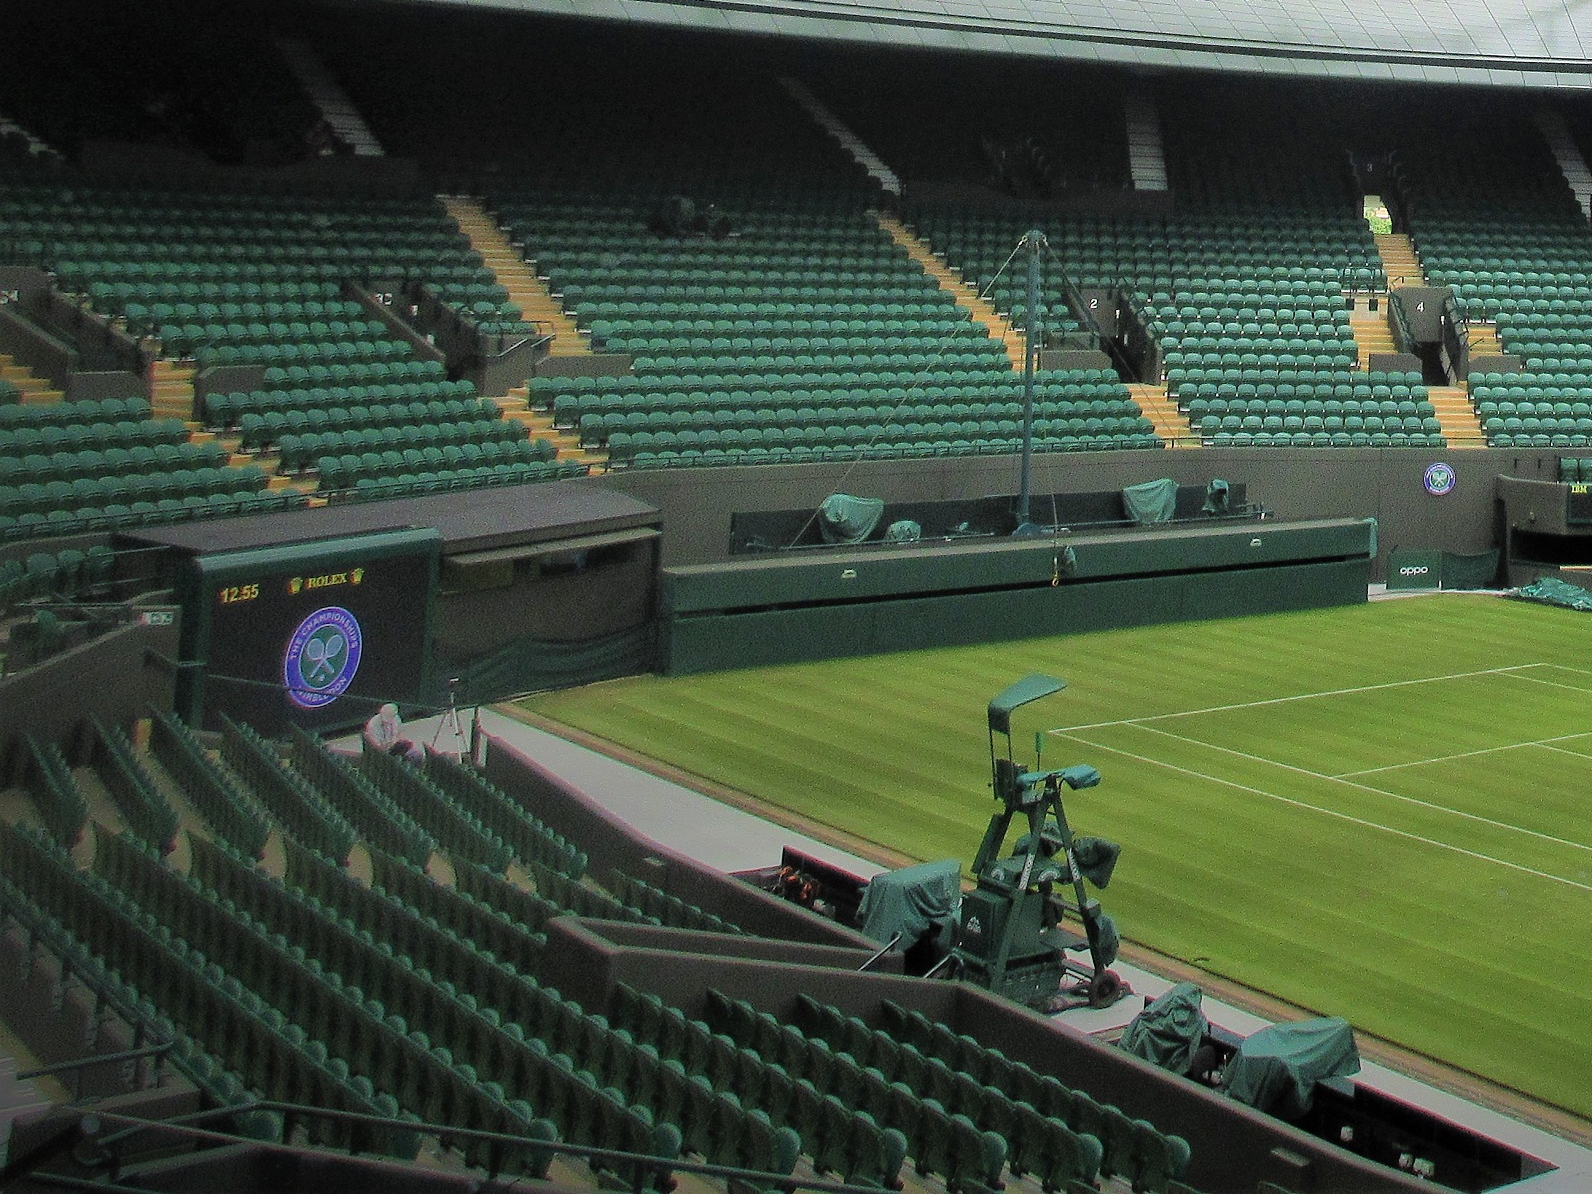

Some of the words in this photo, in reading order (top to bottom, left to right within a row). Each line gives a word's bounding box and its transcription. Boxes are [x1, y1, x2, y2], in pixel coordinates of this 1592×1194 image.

[1090, 298, 1098, 309] 2
[1416, 301, 1425, 312] 4
[1571, 485, 1588, 494] IBM
[1400, 566, 1429, 576] oppo
[307, 572, 347, 588] ROLEX
[289, 637, 303, 660] THE
[301, 611, 359, 649] CHAMPIONSHIPS
